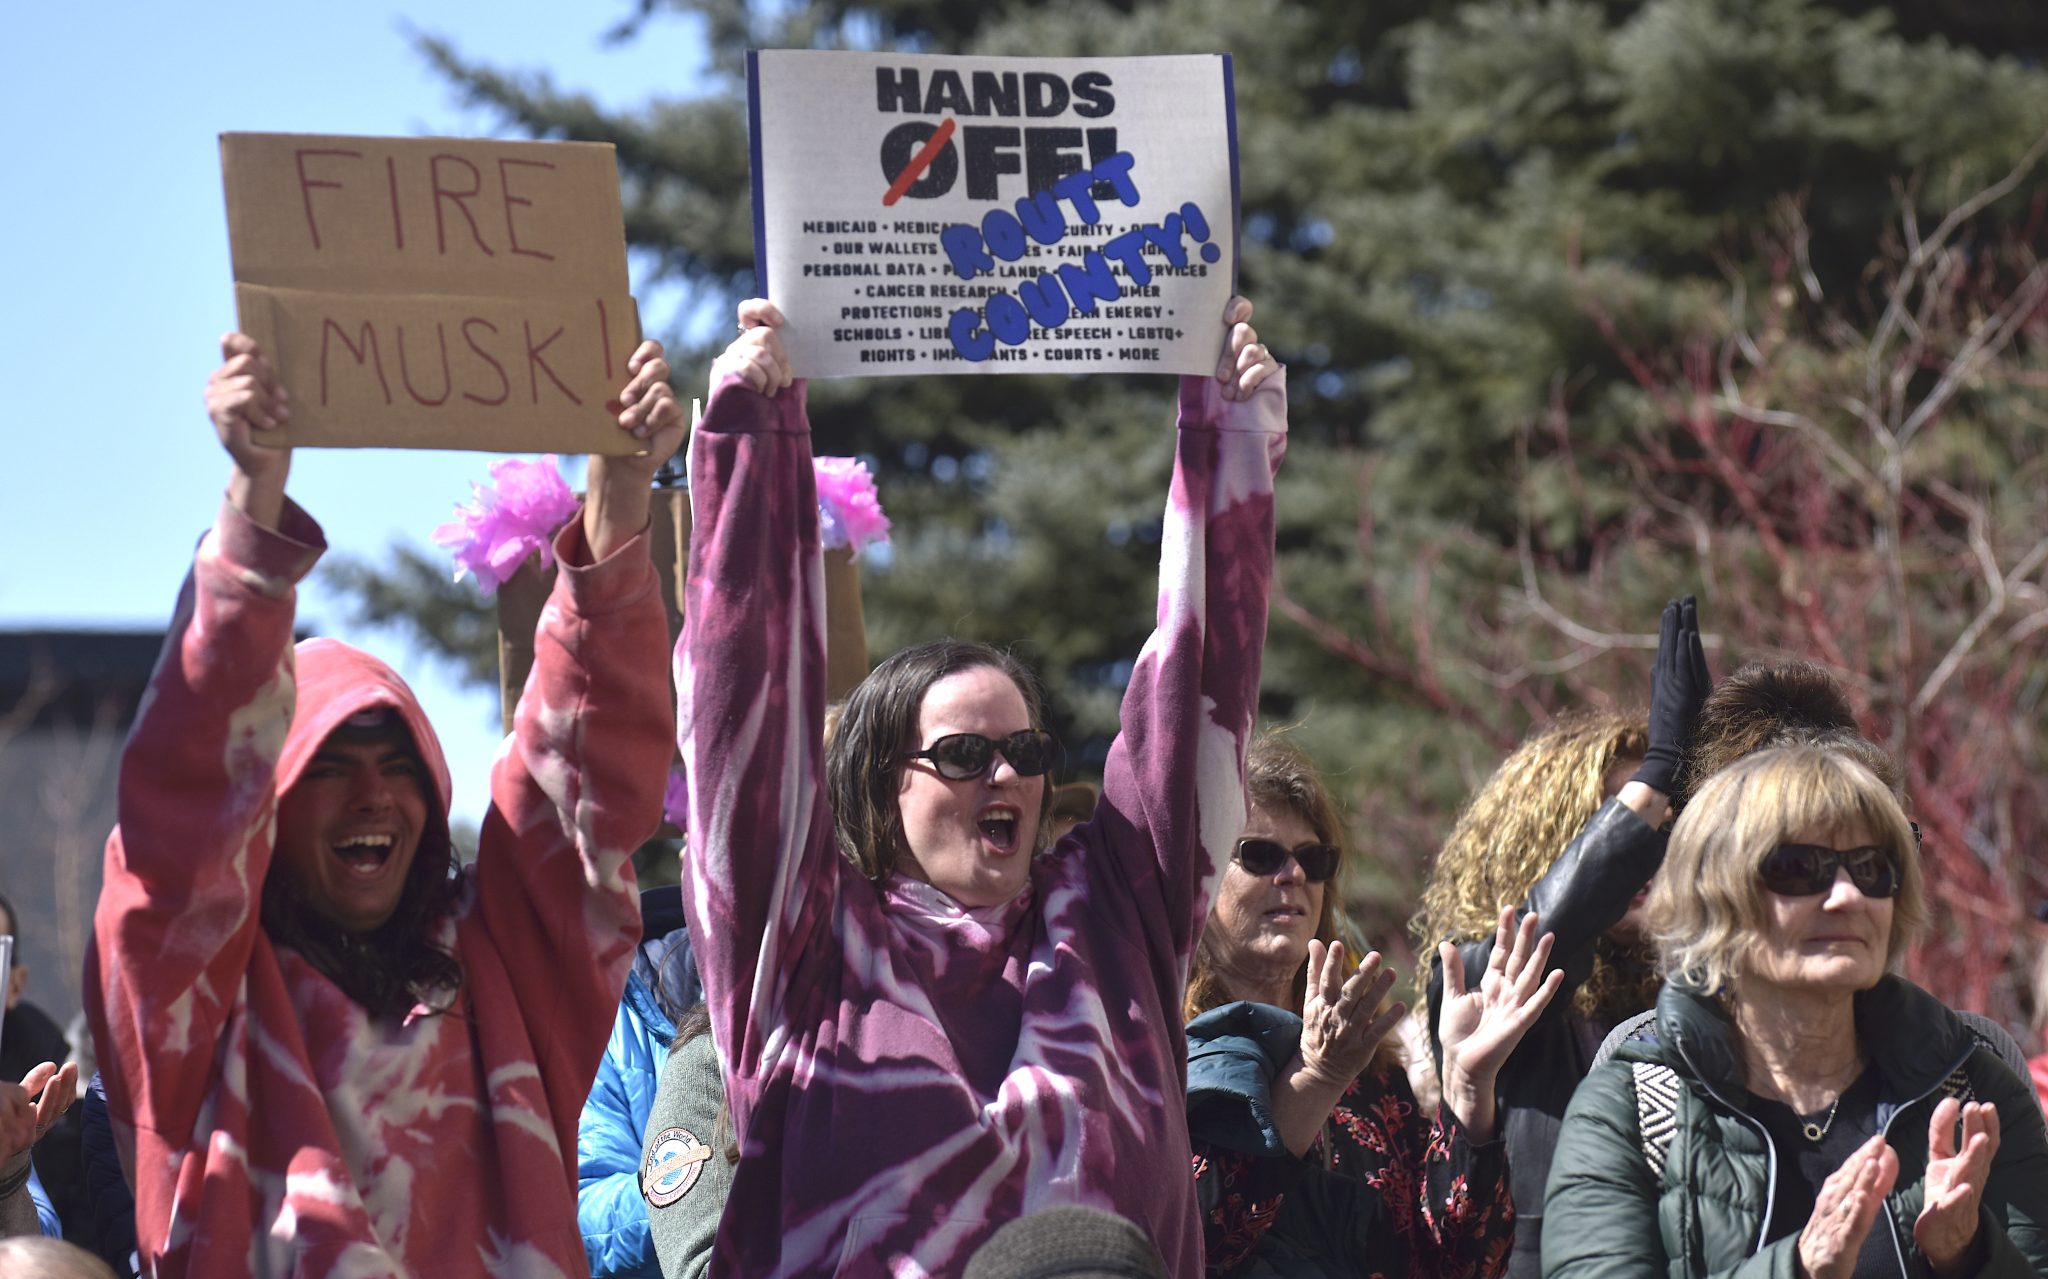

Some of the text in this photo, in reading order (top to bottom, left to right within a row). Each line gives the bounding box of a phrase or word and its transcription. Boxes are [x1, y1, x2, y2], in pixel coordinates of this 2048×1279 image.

[876, 66, 1115, 118] HANDS
[295, 148, 556, 262] FIRE
[940, 151, 1140, 281] ROUTT
[803, 221, 1113, 236] MEDICAID MEDIC CURITY
[833, 242, 864, 255] OUR
[868, 242, 938, 255] WALLETS
[803, 263, 881, 277] PERSONAL
[886, 263, 926, 276] DATA
[1146, 264, 1208, 277] ERVICES
[948, 202, 1221, 361] COUNTY!
[866, 285, 925, 298] CANCER
[841, 306, 942, 319] PROTECTIONS
[1105, 306, 1162, 319] ENERGY
[833, 328, 902, 342] SCHOOLS
[1055, 327, 1112, 340] SPEECH
[1128, 327, 1184, 341] LGBTQ+
[319, 297, 622, 416] MUSK!
[860, 348, 1160, 362] RIGHTS IMMANTS COURTS MORE
[673, 1131, 692, 1143] World
